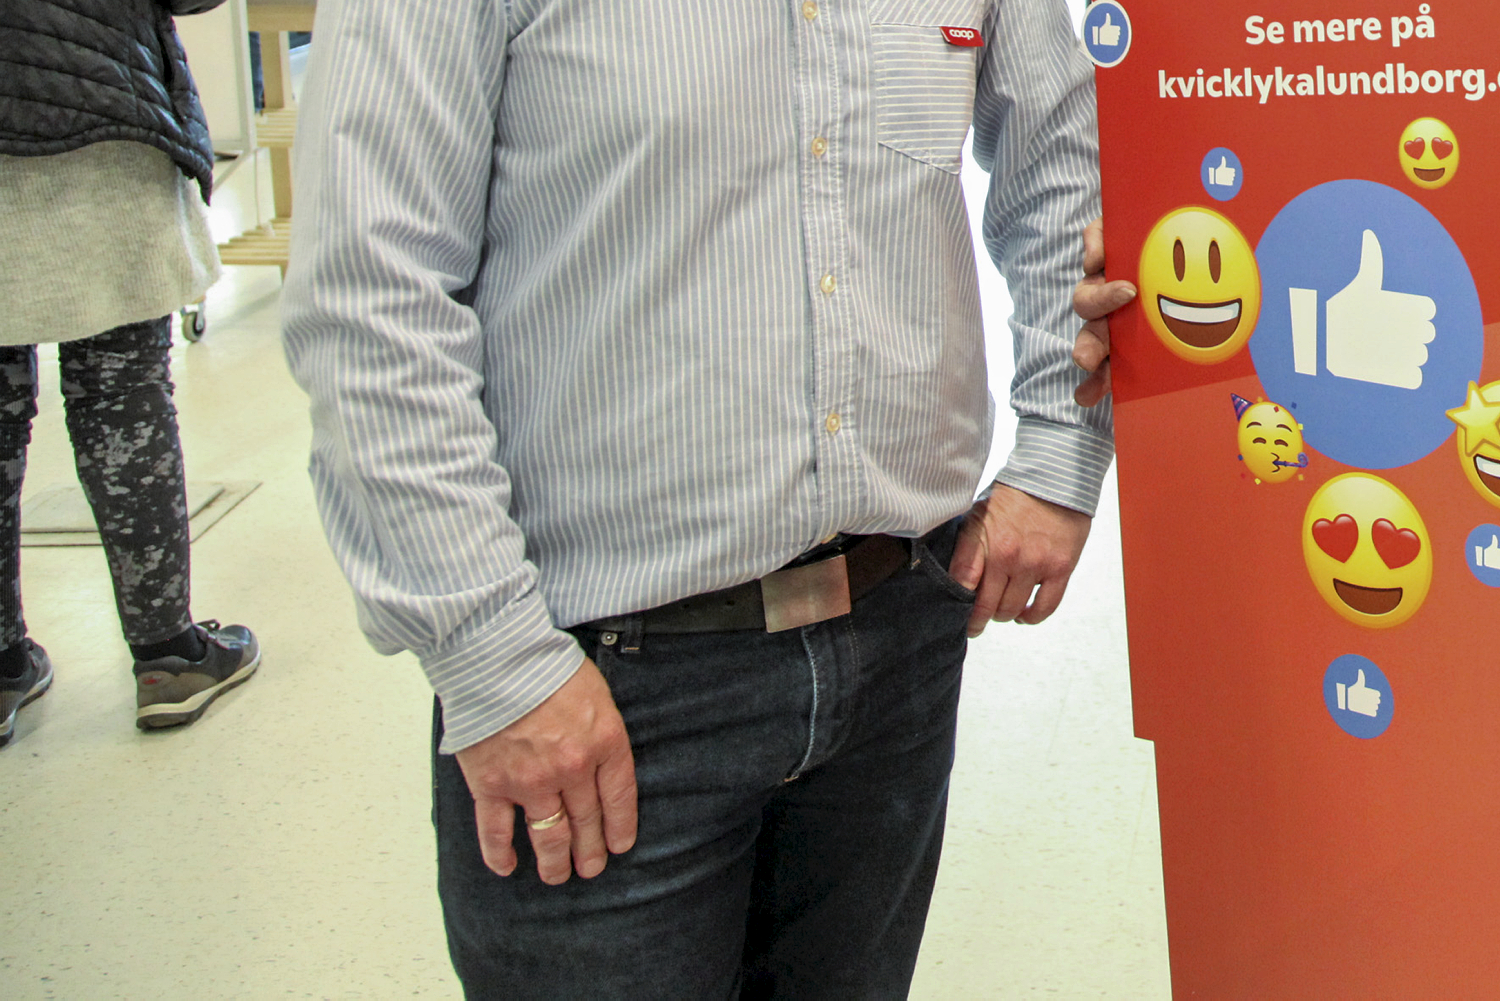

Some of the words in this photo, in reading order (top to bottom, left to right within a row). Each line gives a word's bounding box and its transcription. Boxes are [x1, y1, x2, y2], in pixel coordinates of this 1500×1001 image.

[949, 28, 975, 41] coop
[1244, 14, 1285, 45] Se
[1293, 16, 1382, 43] mere
[1391, 3, 1436, 48] på
